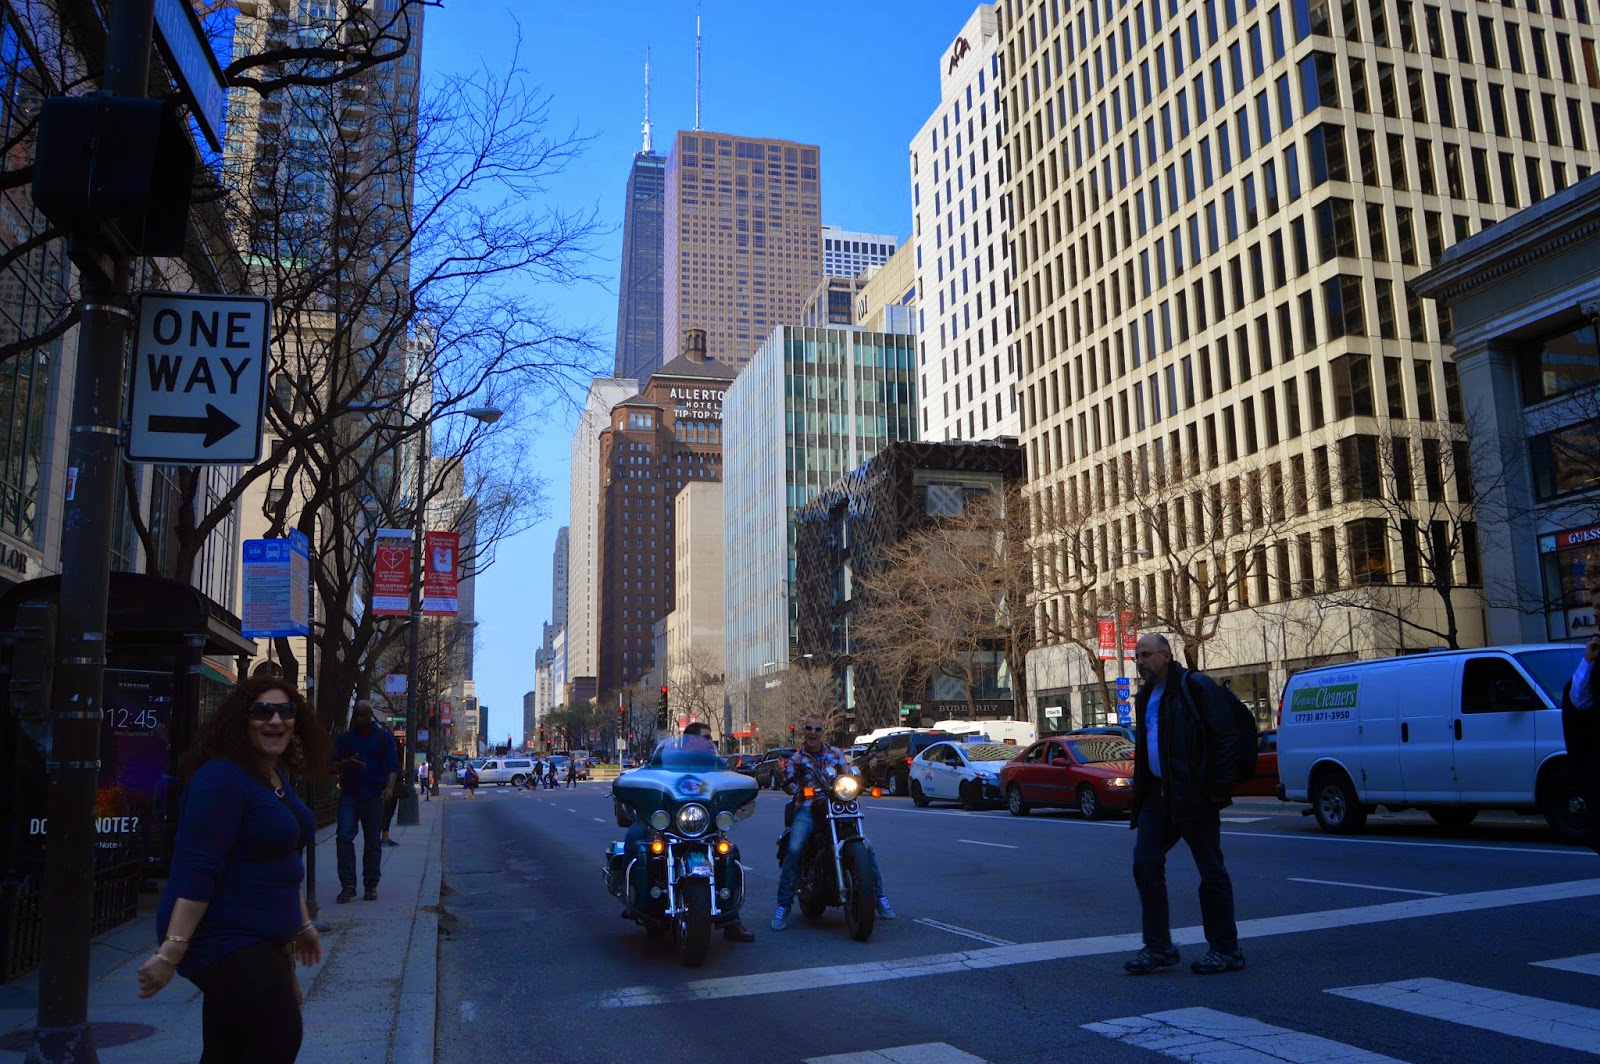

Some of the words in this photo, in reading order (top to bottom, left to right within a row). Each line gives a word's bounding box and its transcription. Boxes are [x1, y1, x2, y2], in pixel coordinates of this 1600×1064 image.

[153, 308, 251, 349] ONE
[147, 354, 252, 395] WAY
[686, 401, 718, 409] HOTEL
[1351, 673, 1358, 682] by
[1315, 687, 1356, 708] Cleaners
[938, 704, 998, 712] BURBRRY
[1295, 713, 1313, 722] (773)
[1315, 711, 1350, 720] 871-3950
[106, 708, 157, 728] 12:45
[95, 816, 139, 833] NOTE?
